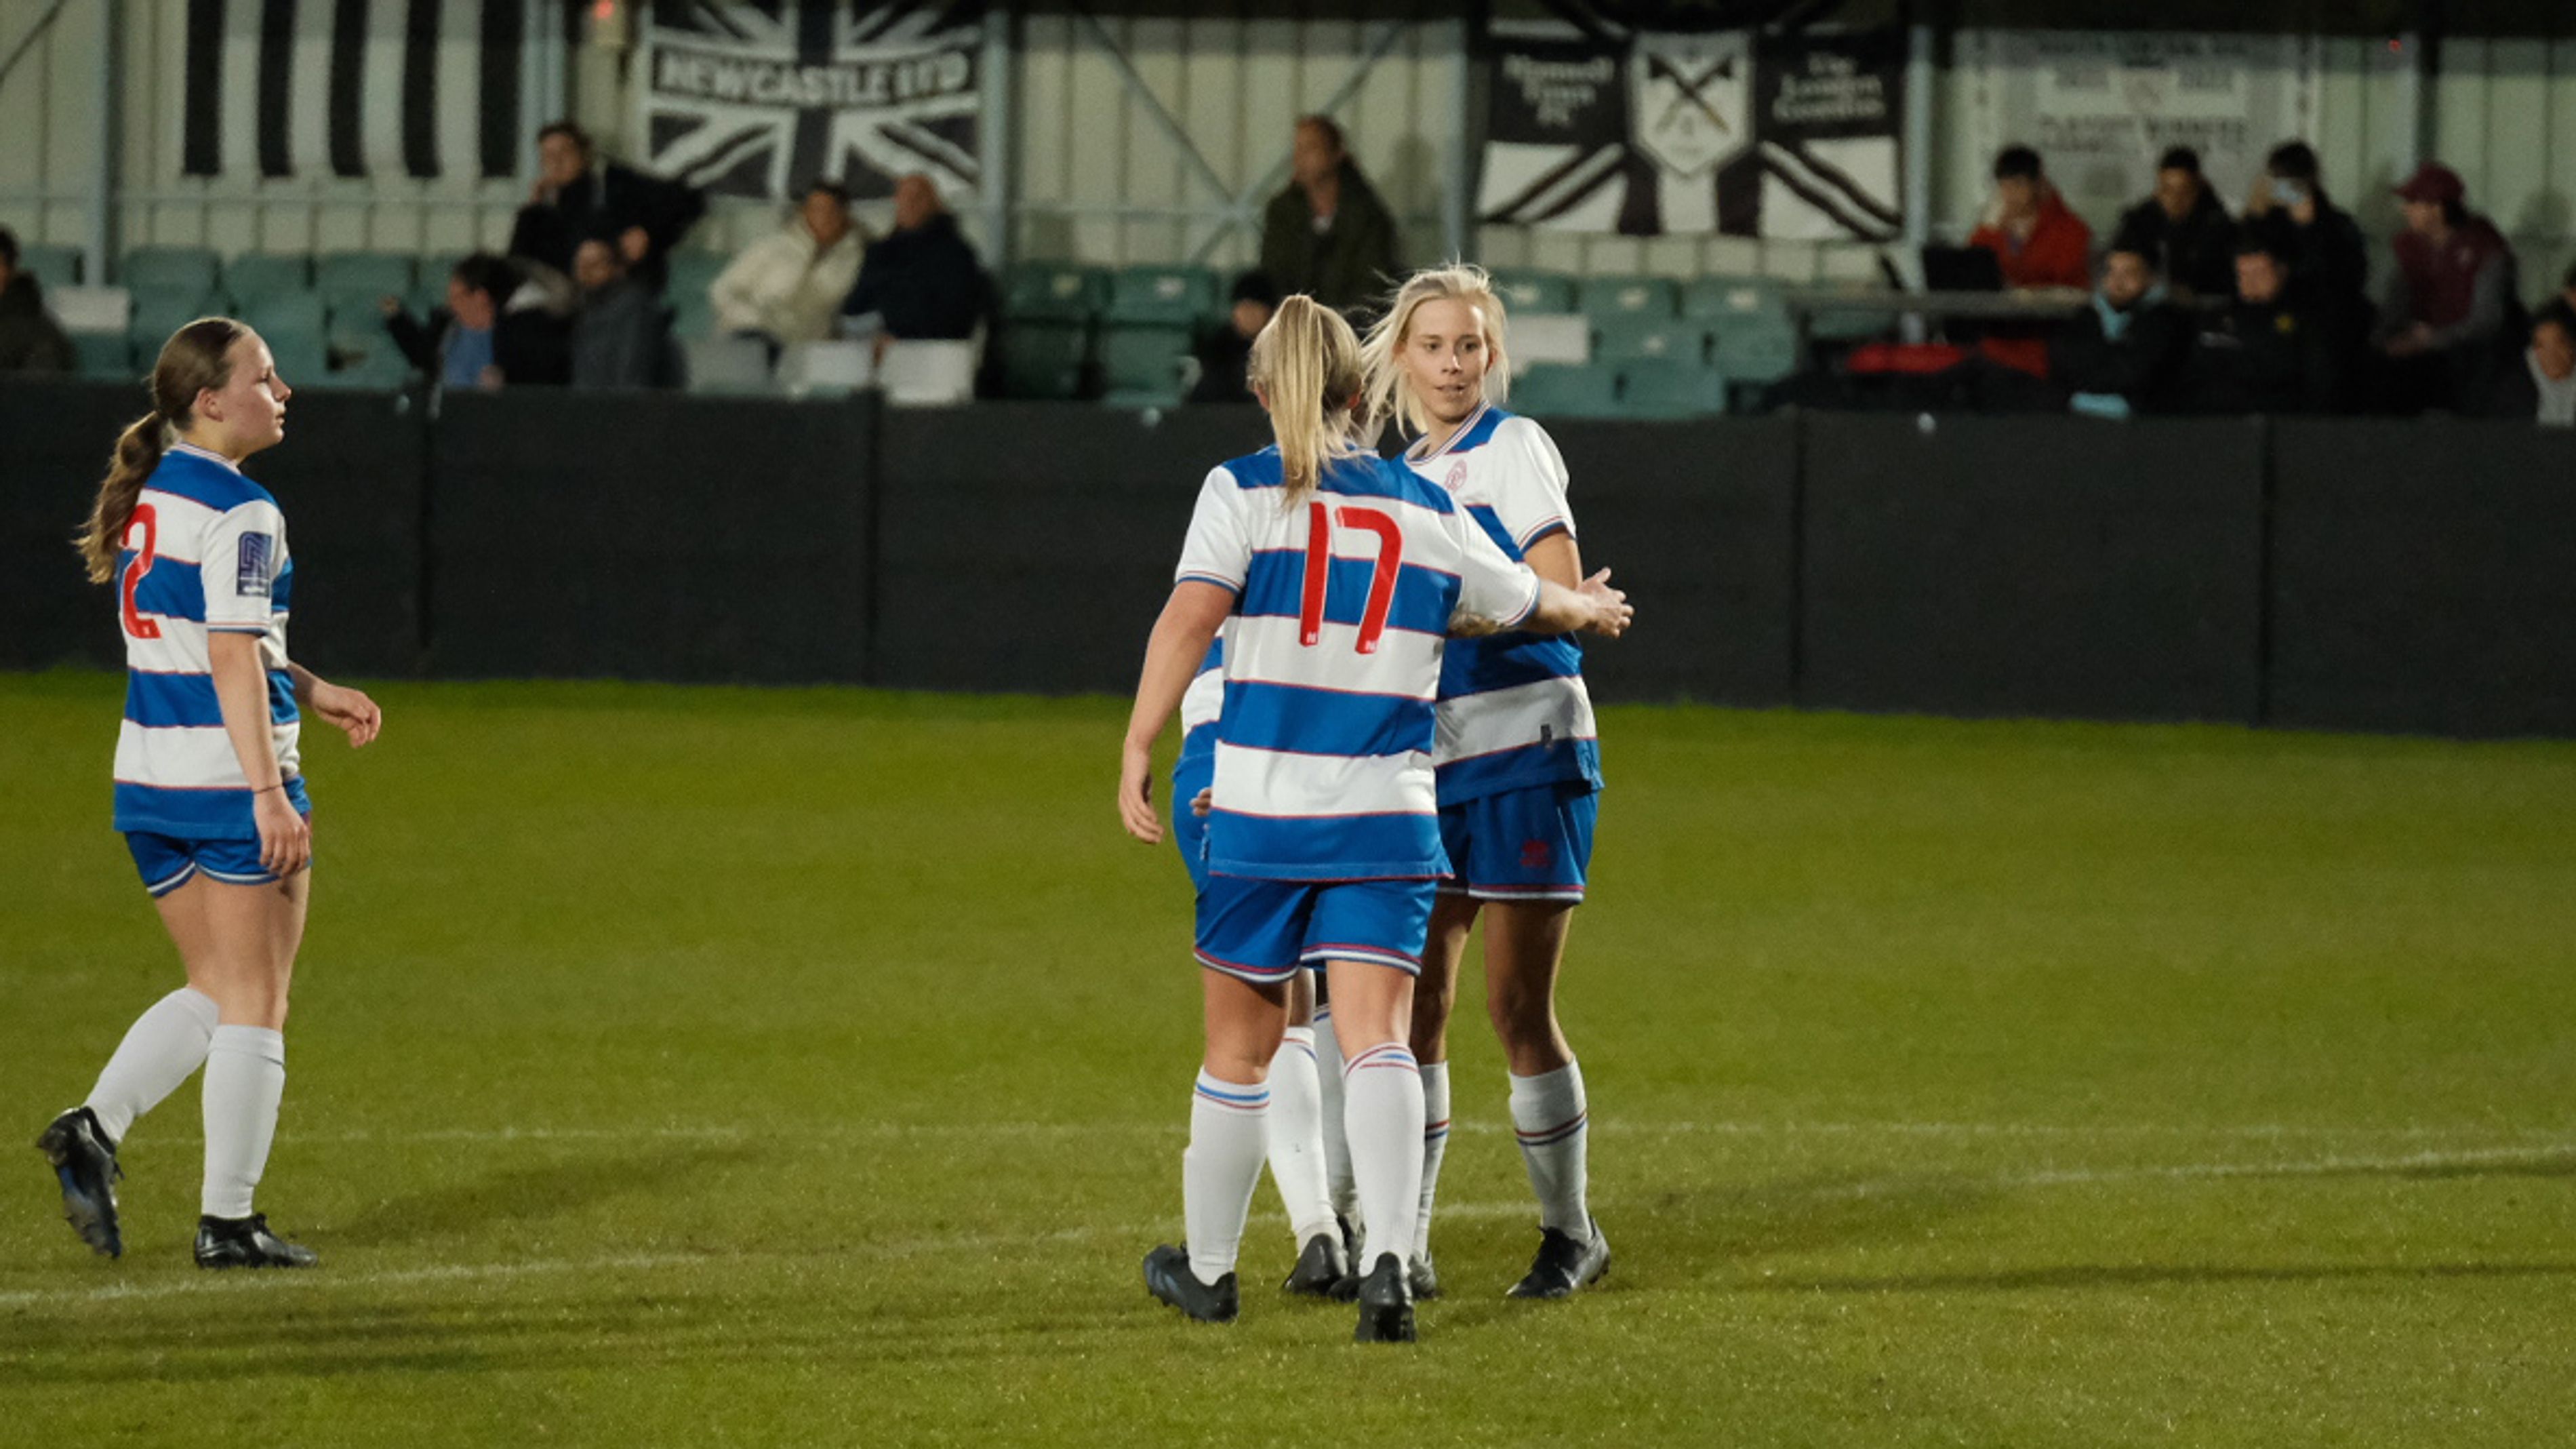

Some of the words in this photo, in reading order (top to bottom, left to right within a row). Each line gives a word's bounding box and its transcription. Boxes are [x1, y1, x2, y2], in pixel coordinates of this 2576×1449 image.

[660, 53, 889, 104] NEWCASTLE
[122, 503, 161, 638] 2
[1300, 502, 1401, 654] 17
